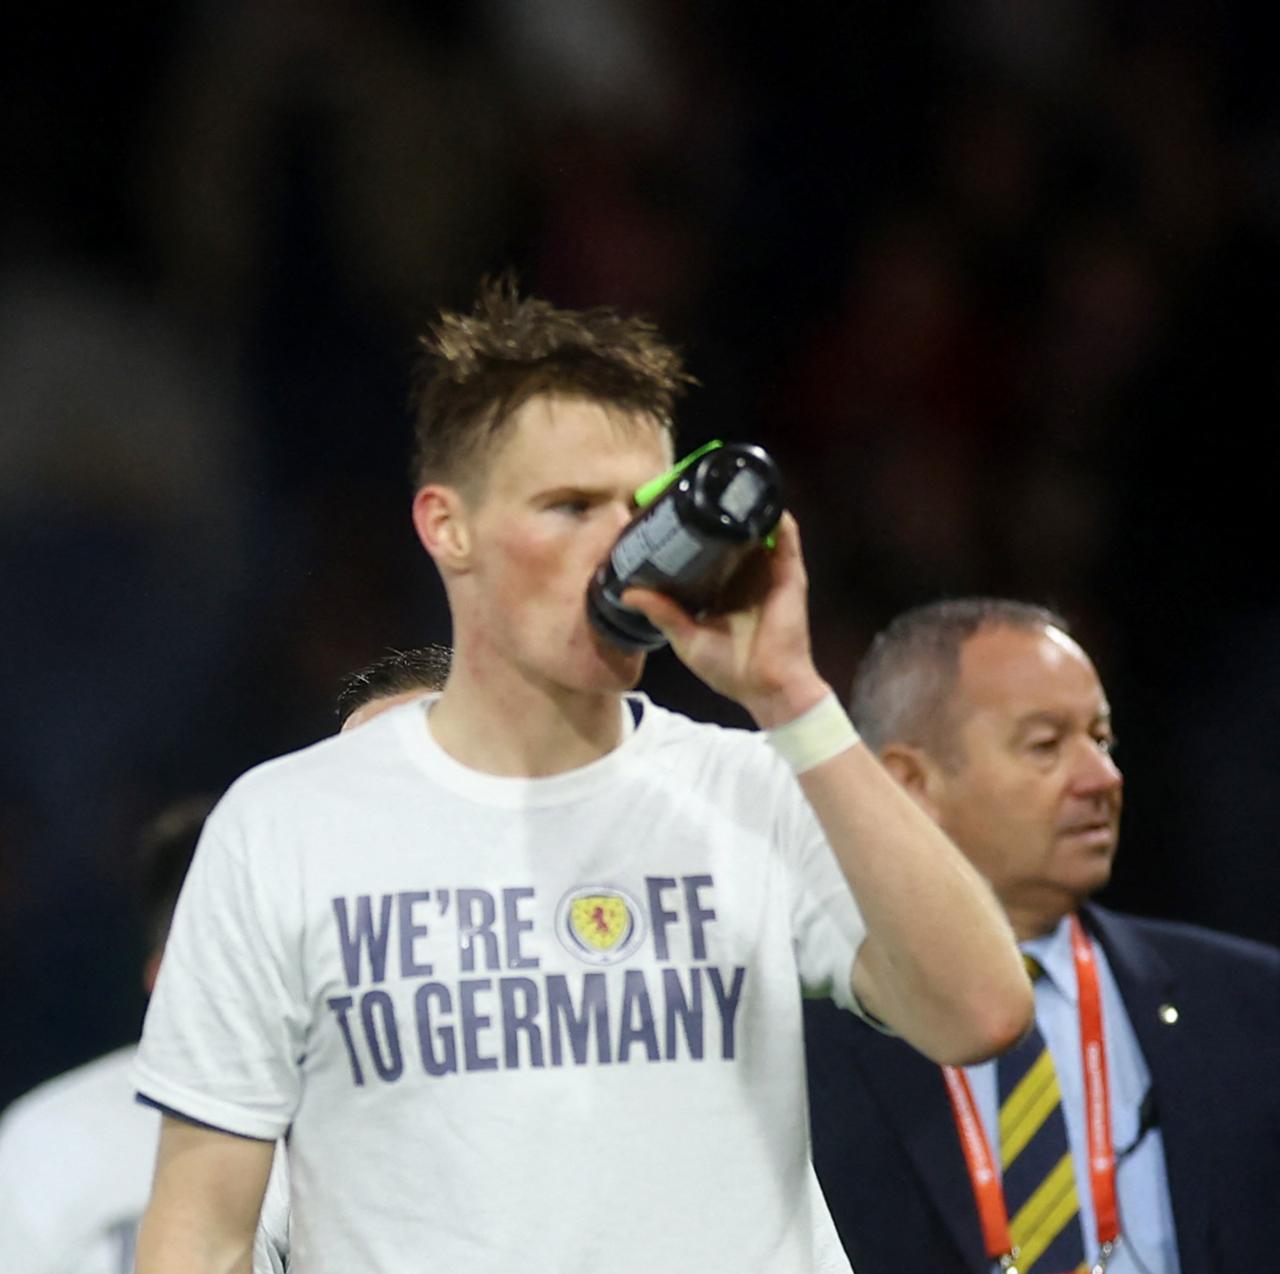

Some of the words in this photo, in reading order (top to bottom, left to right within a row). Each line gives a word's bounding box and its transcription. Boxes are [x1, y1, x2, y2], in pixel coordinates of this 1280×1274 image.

[332, 887, 540, 988] WE'RE
[327, 989, 403, 1087] TO
[414, 966, 745, 1077] GERMANY
